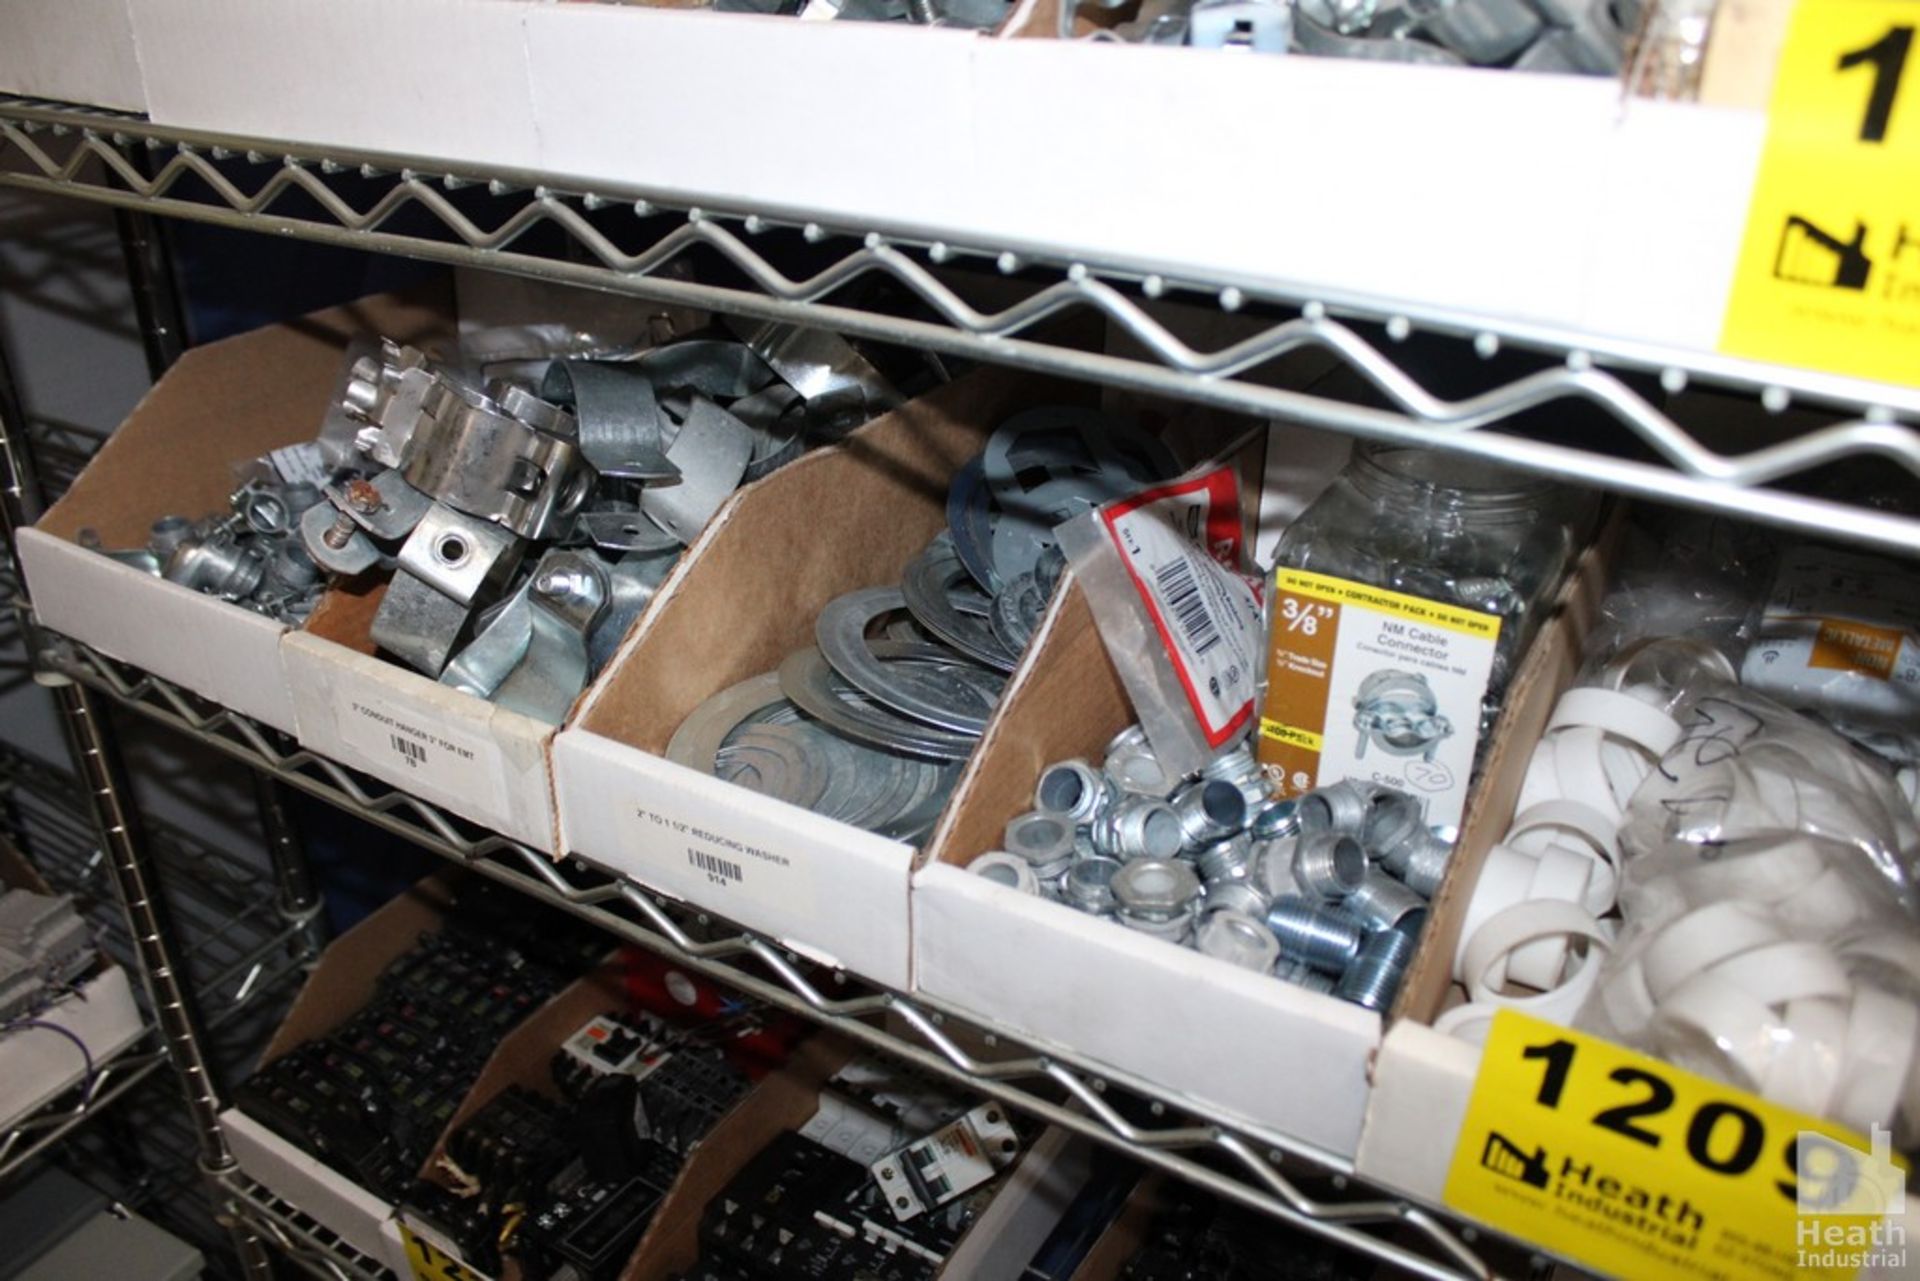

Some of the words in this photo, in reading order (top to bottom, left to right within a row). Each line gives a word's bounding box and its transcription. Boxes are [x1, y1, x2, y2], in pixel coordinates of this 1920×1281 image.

[1345, 589, 1400, 608] CONTRACTOR
[1403, 603, 1427, 616] PACK
[1377, 632, 1449, 661] Connector
[1381, 620, 1405, 635] NM
[1408, 627, 1448, 647] Cable
[395, 720, 428, 740] HANGER
[438, 739, 456, 752] FOR
[457, 747, 475, 761] EMT
[649, 812, 663, 824] TO
[691, 827, 744, 852] REDUCING
[746, 845, 791, 866] WASHER
[707, 873, 727, 887] 914
[1521, 1038, 1860, 1210] 1209
[1560, 1156, 1705, 1231] Heath
[1554, 1181, 1700, 1251] Industrial
